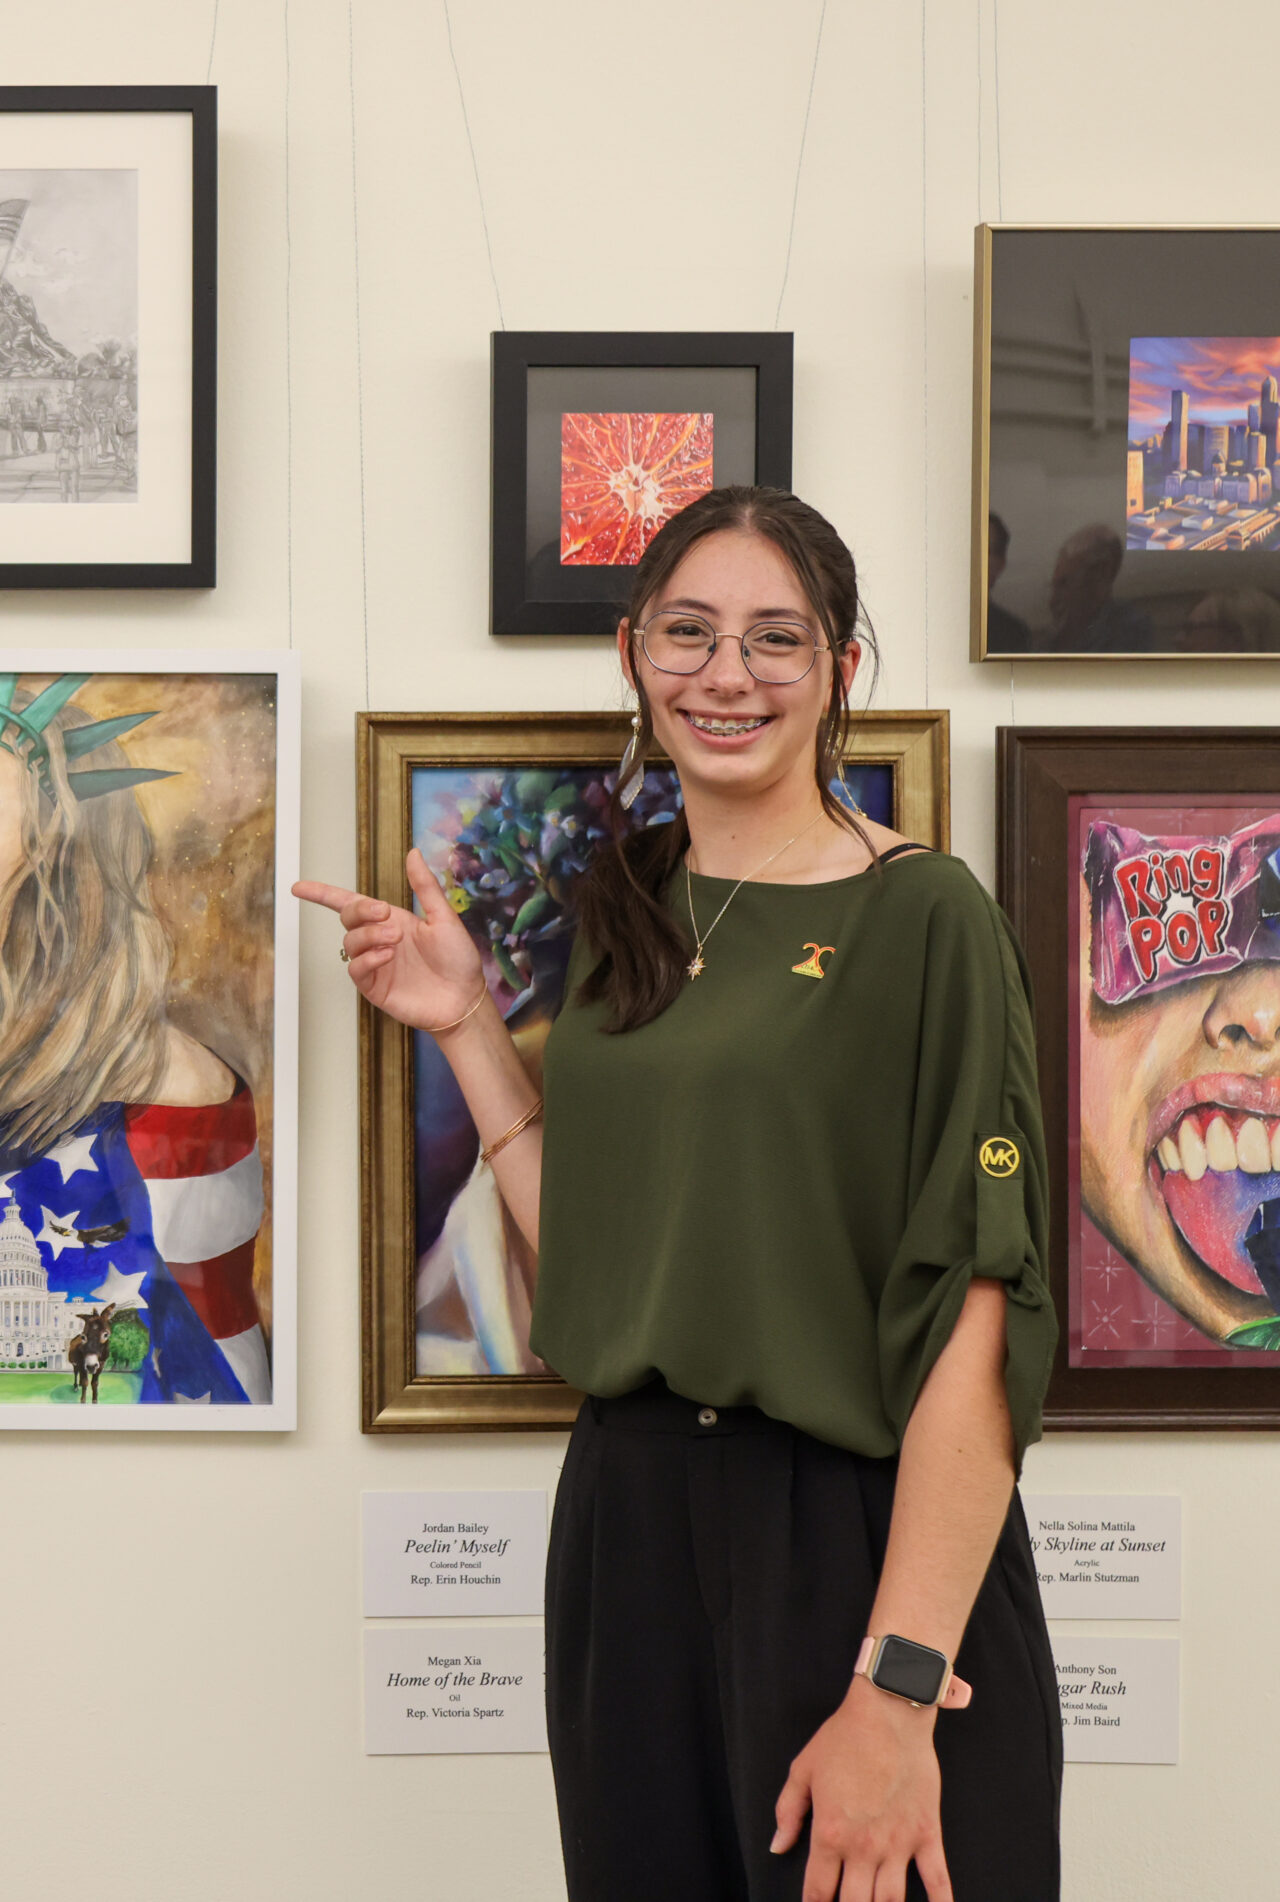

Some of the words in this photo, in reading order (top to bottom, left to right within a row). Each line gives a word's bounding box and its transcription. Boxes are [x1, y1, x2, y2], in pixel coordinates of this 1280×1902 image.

[1115, 848, 1224, 921] Ring
[1129, 899, 1227, 981] POP
[422, 1523, 455, 1534] Jordan
[457, 1523, 489, 1536] Bailey
[1038, 1520, 1065, 1531] Nella
[1067, 1520, 1098, 1531] Solina
[1101, 1521, 1136, 1532] Mattila
[458, 1538, 512, 1557] Myself
[1044, 1536, 1097, 1555] Skyline
[1099, 1539, 1115, 1552] at
[1117, 1537, 1167, 1553] Sunset
[429, 1560, 458, 1570] Colored
[460, 1560, 482, 1570] Pencil
[1073, 1559, 1100, 1569] Acrylic
[410, 1574, 433, 1587] Rep.
[435, 1574, 457, 1585] Erin
[459, 1574, 502, 1585] Houchin
[1058, 1571, 1092, 1583] Marlin
[1094, 1571, 1140, 1583] Stutzman
[427, 1655, 462, 1669] Megan
[464, 1655, 482, 1666] Xia
[1055, 1663, 1096, 1677] Anthony
[1097, 1664, 1118, 1676] Son
[387, 1672, 431, 1687] Home
[434, 1671, 453, 1690] of
[454, 1672, 476, 1686] the
[479, 1671, 524, 1686] Brave
[1090, 1680, 1127, 1696] Rush
[448, 1693, 461, 1702] Oil
[1061, 1701, 1085, 1711] Mixed
[1085, 1702, 1108, 1712] Media
[406, 1707, 429, 1721] Rep.
[431, 1706, 471, 1718] Victoria
[472, 1706, 505, 1720] Spartz
[1072, 1715, 1092, 1727] Jim
[1093, 1715, 1121, 1727] Baird
